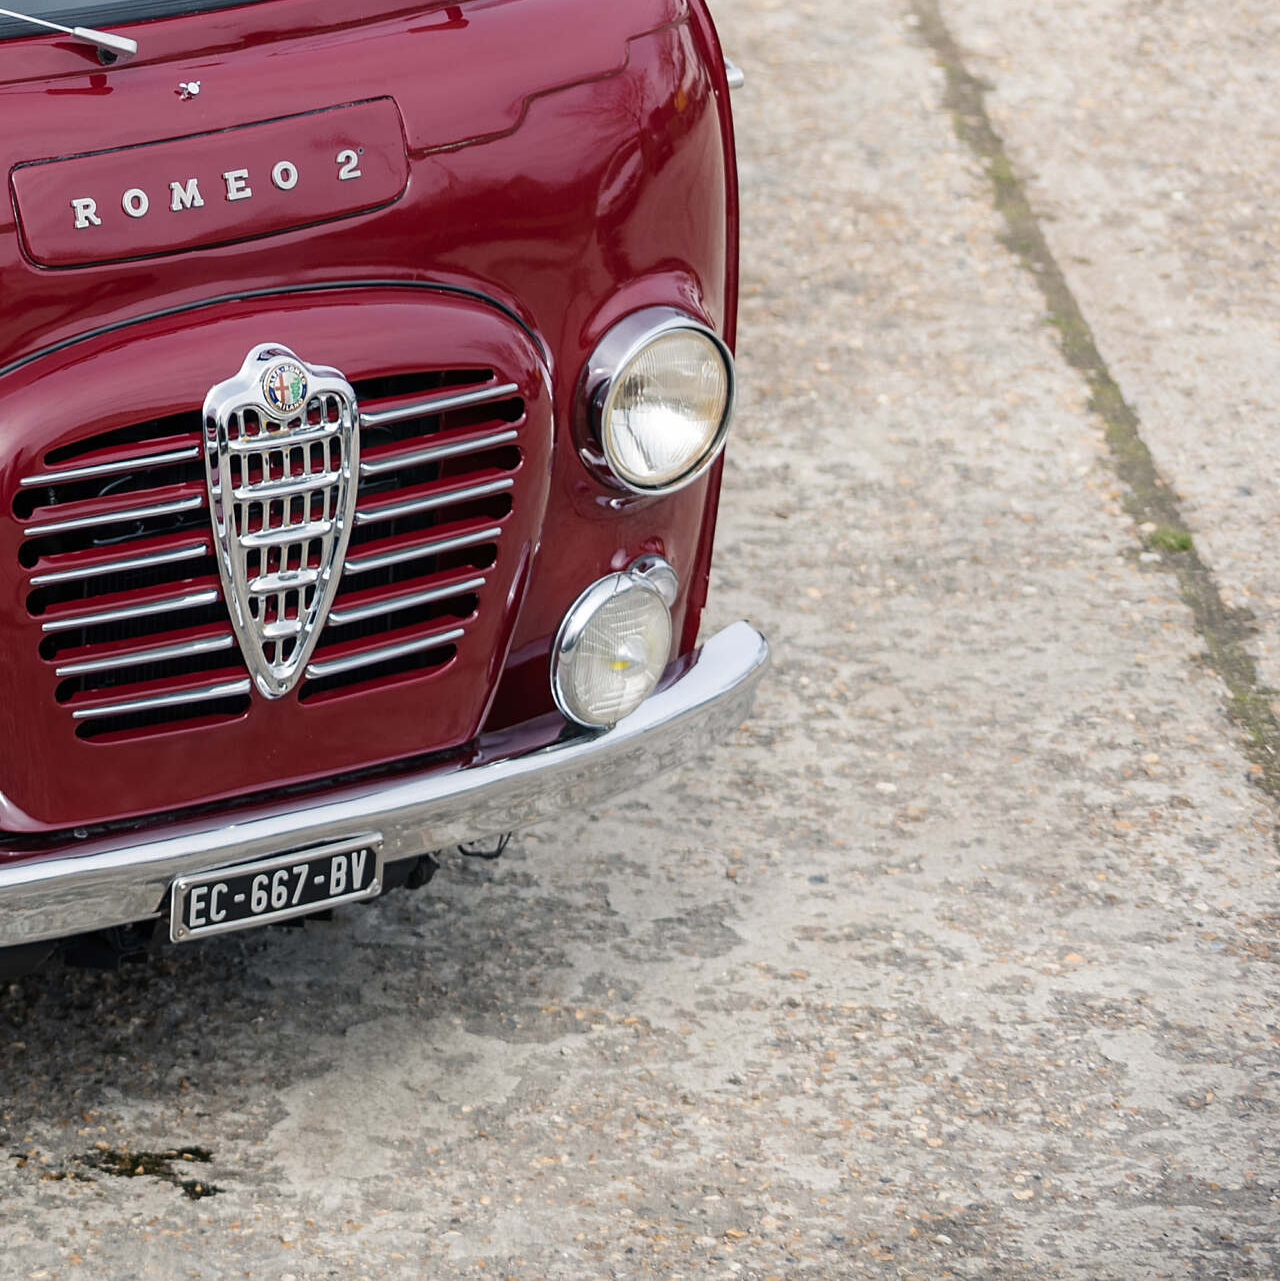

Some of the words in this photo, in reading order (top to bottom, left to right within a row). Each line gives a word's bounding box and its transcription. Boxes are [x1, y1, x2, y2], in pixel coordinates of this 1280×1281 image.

[70, 160, 299, 229] ROMEO
[336, 149, 363, 181] 2
[189, 849, 368, 928] EC-667-BV
